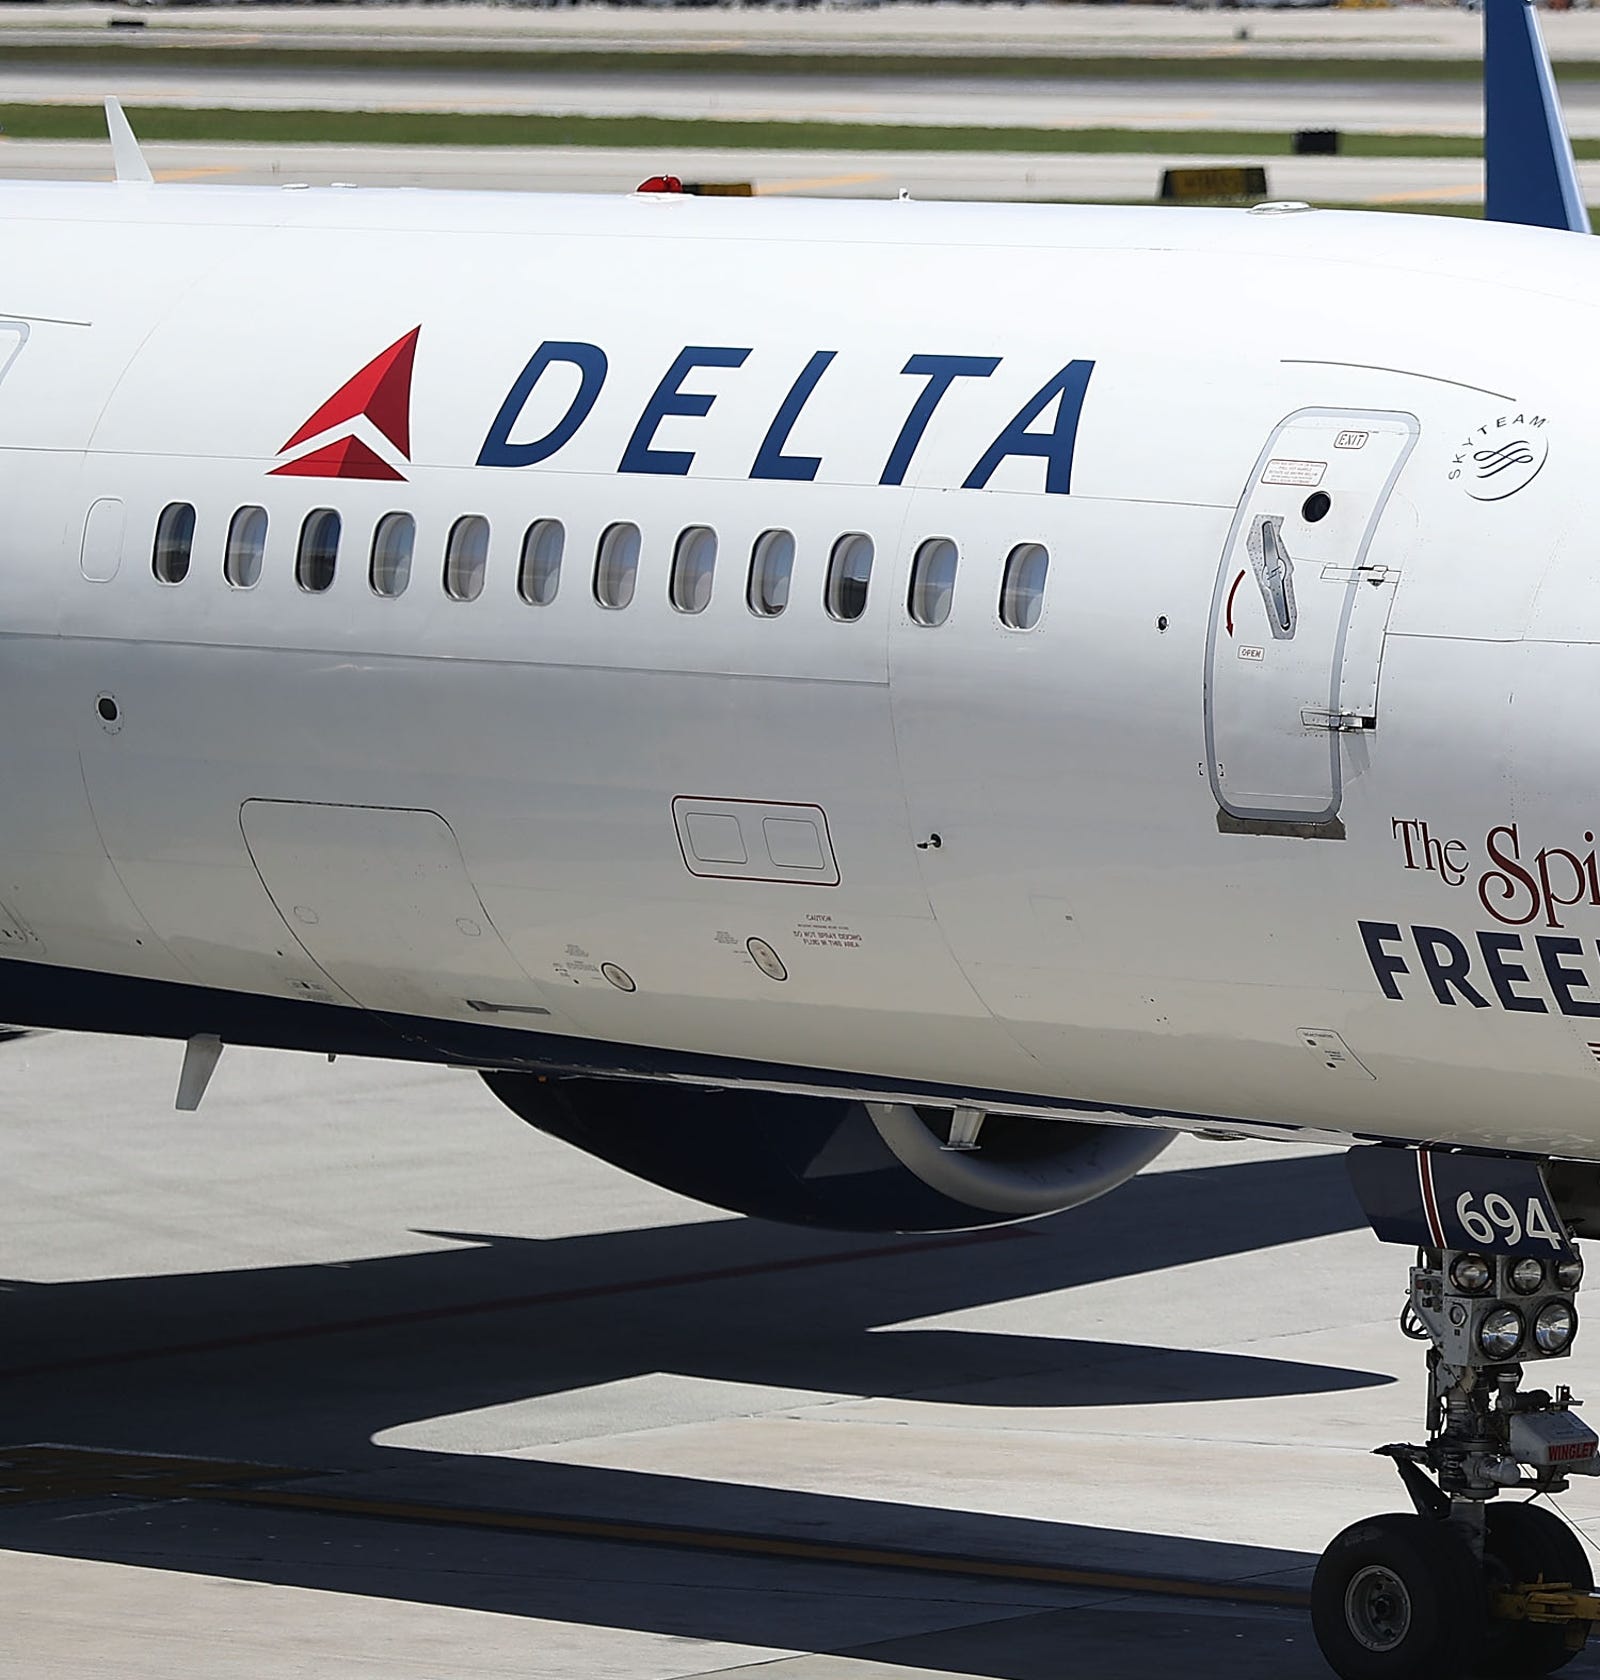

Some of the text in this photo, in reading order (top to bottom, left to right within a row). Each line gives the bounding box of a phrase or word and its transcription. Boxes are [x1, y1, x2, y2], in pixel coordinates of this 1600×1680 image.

[474, 340, 1097, 495] DELTA
[1338, 433, 1365, 446] EXIT
[1447, 413, 1547, 480] SKYTEAM
[1241, 648, 1262, 658] OPEN
[1391, 817, 1470, 887] The
[1456, 1191, 1562, 1250] 694
